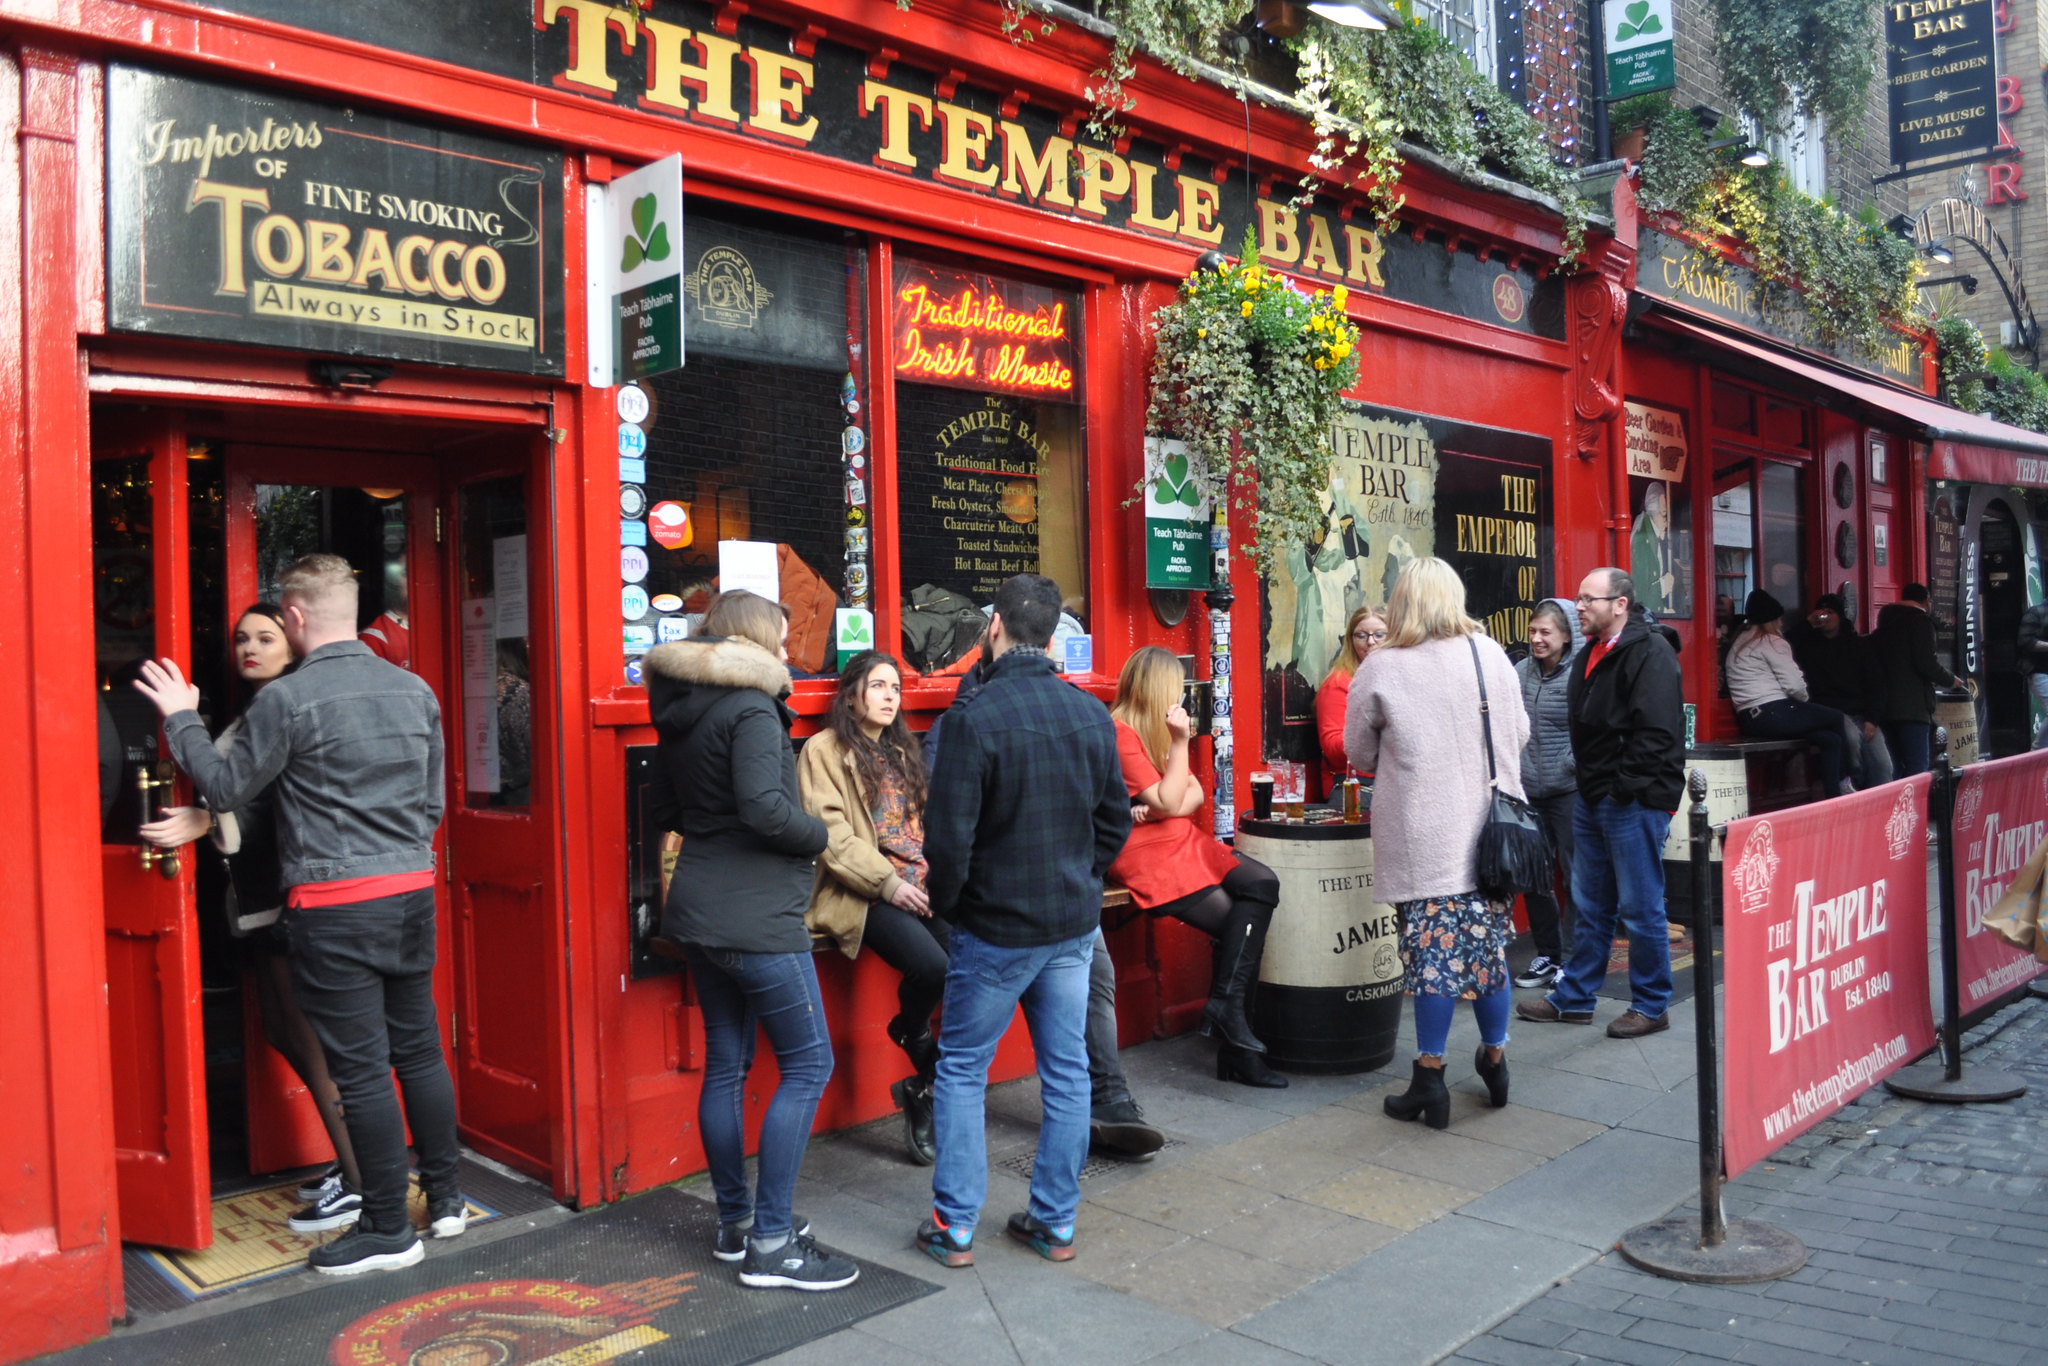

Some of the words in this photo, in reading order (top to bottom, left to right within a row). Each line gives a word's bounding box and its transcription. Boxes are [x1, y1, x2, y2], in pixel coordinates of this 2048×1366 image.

[1890, 0, 1988, 22] TEMP
[1913, 14, 1966, 40] BAR
[1634, 61, 1647, 69] Pub
[1895, 69, 1929, 85] BEER
[1931, 55, 1987, 77] GARDEN
[1900, 116, 1933, 133] LIVE
[1936, 106, 1986, 124] MUSIC
[136, 117, 323, 176] Importers
[541, 0, 819, 142] THE
[862, 79, 1225, 246] TEMPLE
[1257, 198, 1385, 289] BAR
[1919, 125, 1965, 144] DAILY
[256, 157, 287, 180] OF
[304, 181, 371, 214] FINE
[378, 194, 504, 237] SMOKING
[186, 179, 506, 304] TOBACCO
[708, 250, 744, 267] TEMPLE
[1497, 281, 1517, 312] 48
[260, 285, 381, 322] Always
[400, 303, 428, 328] in
[441, 306, 530, 343] Stock
[619, 300, 639, 319] Teach
[639, 314, 653, 329] Pub
[902, 285, 1064, 337] Traditional
[896, 328, 975, 376] Irish
[989, 344, 1072, 390] Music
[985, 396, 1000, 409] The
[936, 411, 1012, 449] TEMPLE
[1017, 420, 1050, 460] BAR
[1645, 412, 1675, 435] Garden
[1329, 424, 1431, 469] TEMPLE
[1625, 432, 1659, 457] Smoking
[935, 452, 996, 471] Traditional
[1000, 459, 1025, 474] Food
[1632, 454, 1653, 475] Area
[2016, 457, 2037, 482] THE
[943, 476, 965, 491] Meat
[968, 478, 993, 495] Plate,
[1360, 465, 1410, 504] BAR
[1501, 474, 1536, 515] THE
[931, 495, 956, 510] Fresh
[959, 497, 993, 516] Oysters,
[655, 530, 681, 539] zomato
[943, 516, 995, 532] Charcuterie
[998, 521, 1025, 536] Meats,
[1153, 527, 1172, 539] Teach
[1456, 513, 1537, 559] EMPEROR
[1934, 515, 1953, 535] TEMPLE
[957, 537, 990, 552] Toasted
[1172, 541, 1185, 552] Pub
[955, 557, 971, 570] Hot
[975, 558, 998, 571] Roast
[1001, 559, 1020, 572] Beef
[1023, 560, 1040, 573] Roll
[1166, 564, 1192, 574] APPROVED
[1518, 566, 1536, 602] OF
[1965, 542, 1975, 673] GUINNESS
[664, 625, 681, 636] tax
[1713, 787, 1732, 799] THE
[1968, 840, 1982, 862] THE
[1319, 875, 1353, 893] THE
[1333, 914, 1399, 955] JAMES
[1768, 919, 1791, 953] THE
[1793, 879, 1887, 972] TEMPLE
[1830, 956, 1865, 991] DUBLIN
[1844, 986, 1863, 1011] Est.
[1865, 970, 1891, 1003] 1840
[1766, 957, 1828, 1055] BAR
[1762, 1033, 1907, 1141] www.thetemplebarpub.com
[362, 1285, 518, 1336] TEMPLE
[525, 1283, 600, 1310] BAR
